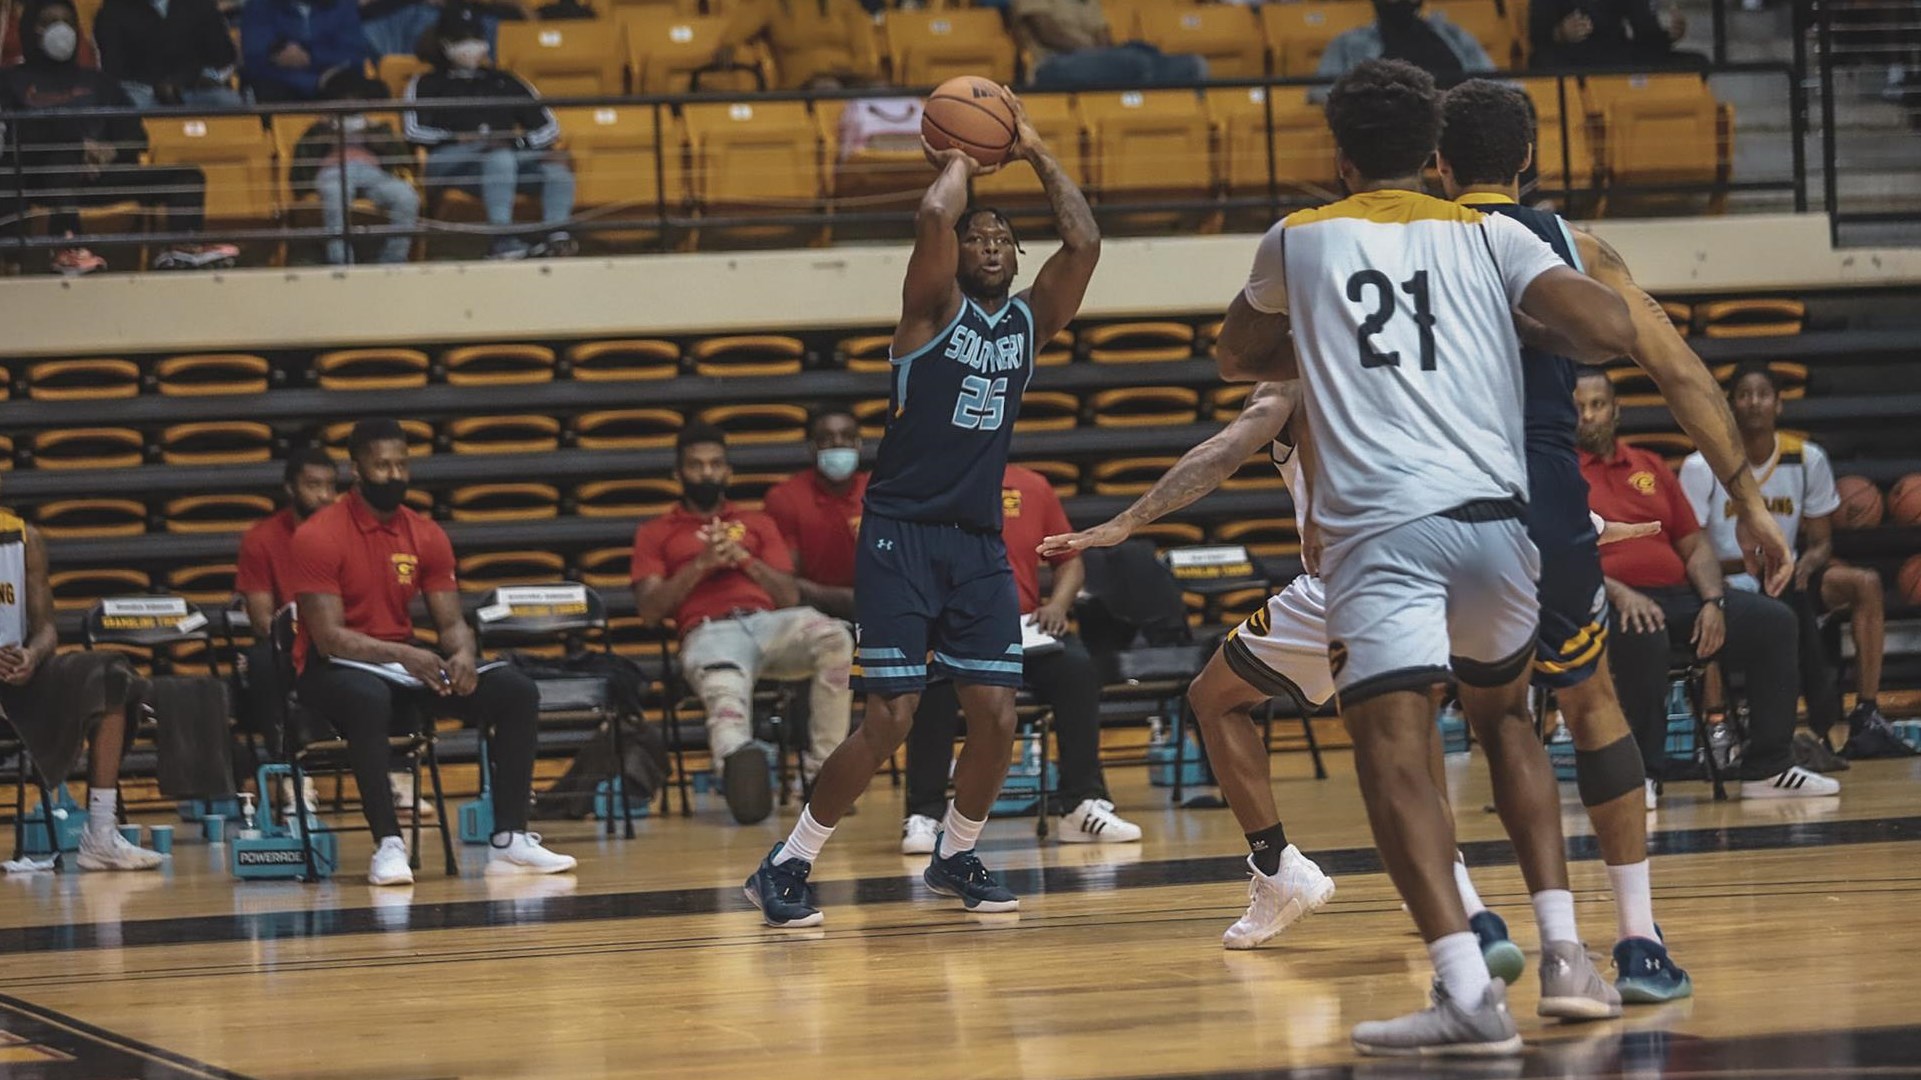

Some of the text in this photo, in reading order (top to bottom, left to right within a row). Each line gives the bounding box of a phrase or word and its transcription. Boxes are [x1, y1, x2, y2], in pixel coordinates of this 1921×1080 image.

[1346, 269, 1437, 371] 21
[952, 374, 1008, 430] 25
[240, 851, 304, 864] POWERADE
